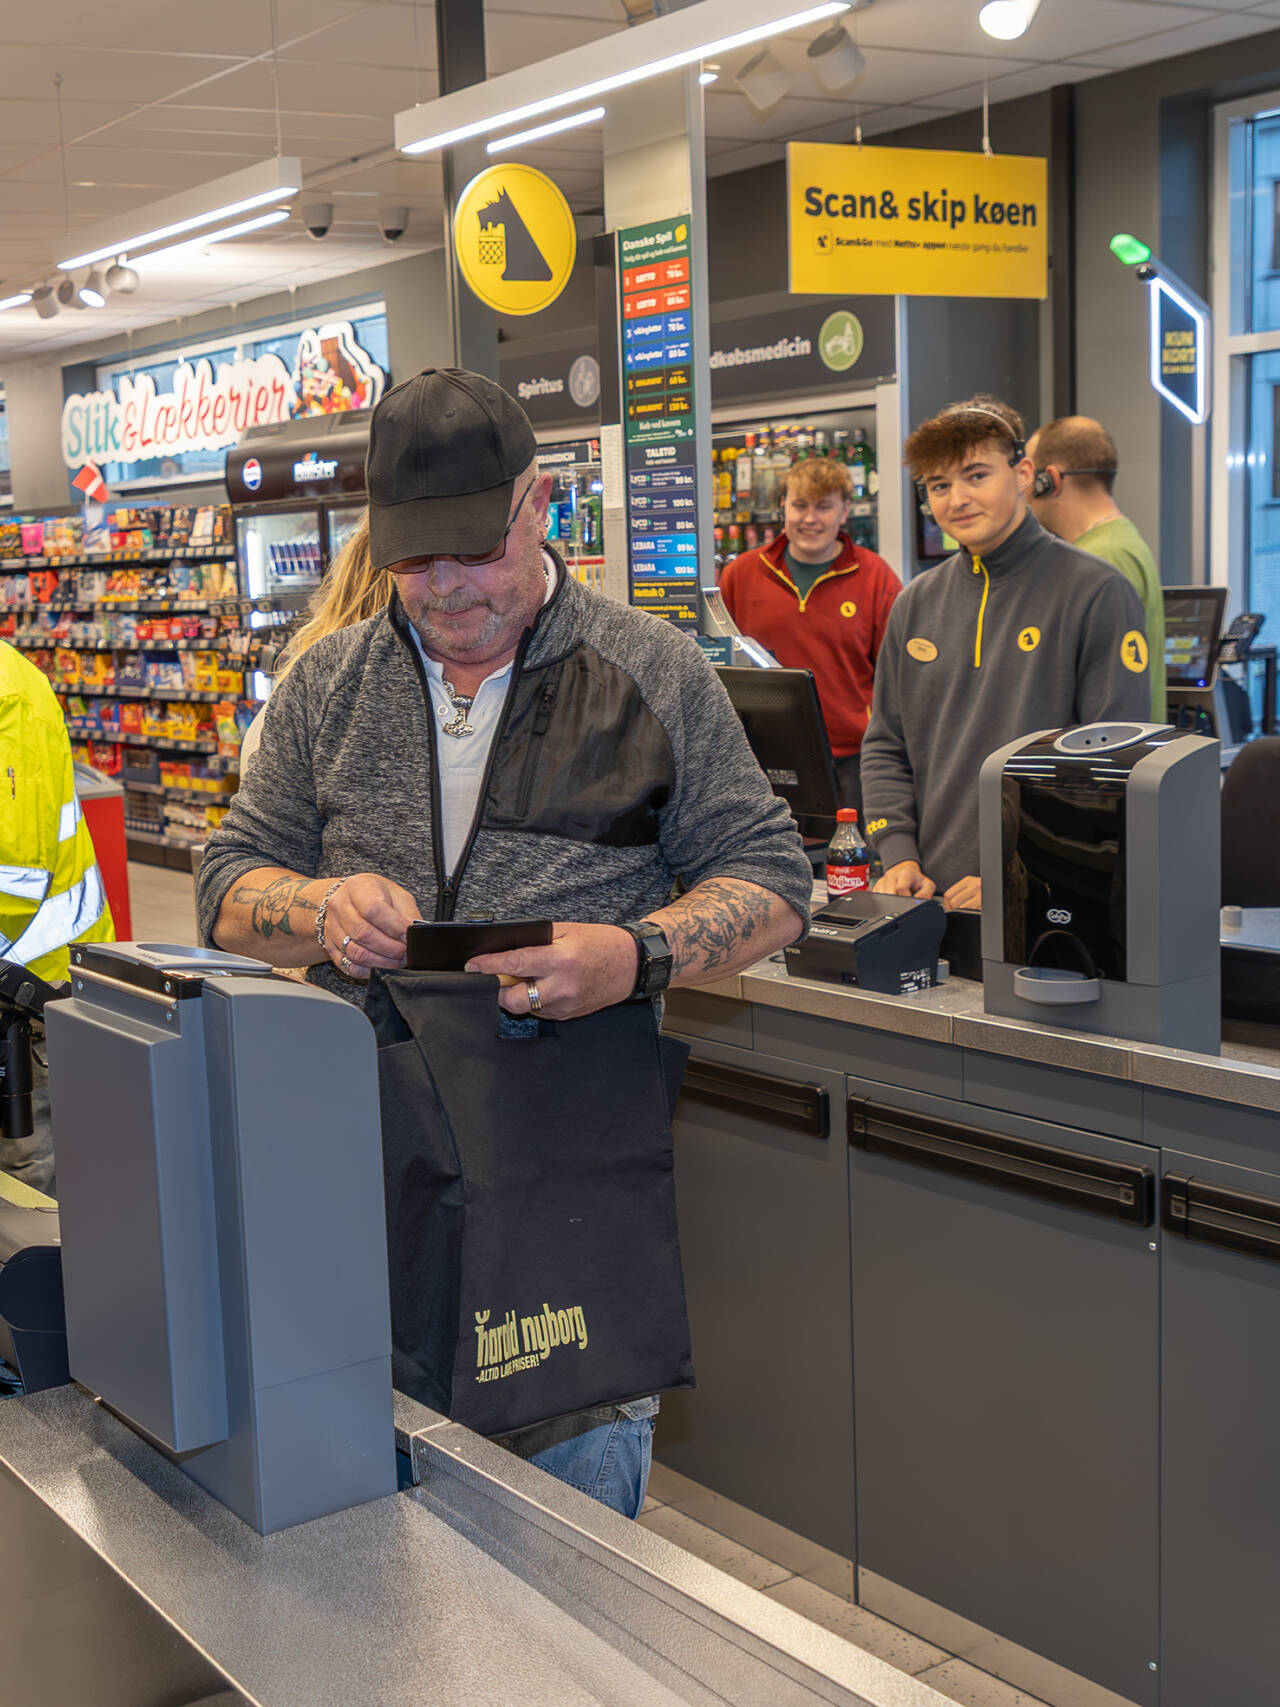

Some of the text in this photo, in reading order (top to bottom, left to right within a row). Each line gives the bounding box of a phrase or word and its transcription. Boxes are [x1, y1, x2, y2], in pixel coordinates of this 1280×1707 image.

[804, 187, 1037, 229] Scan& skip køen
[623, 231, 673, 251] Danske Spil
[518, 377, 564, 400] Spiritus
[645, 446, 676, 458] TALETID
[632, 541, 656, 551] LEBARA
[633, 563, 656, 573] LEBARA
[520, 1303, 588, 1360] nyborg
